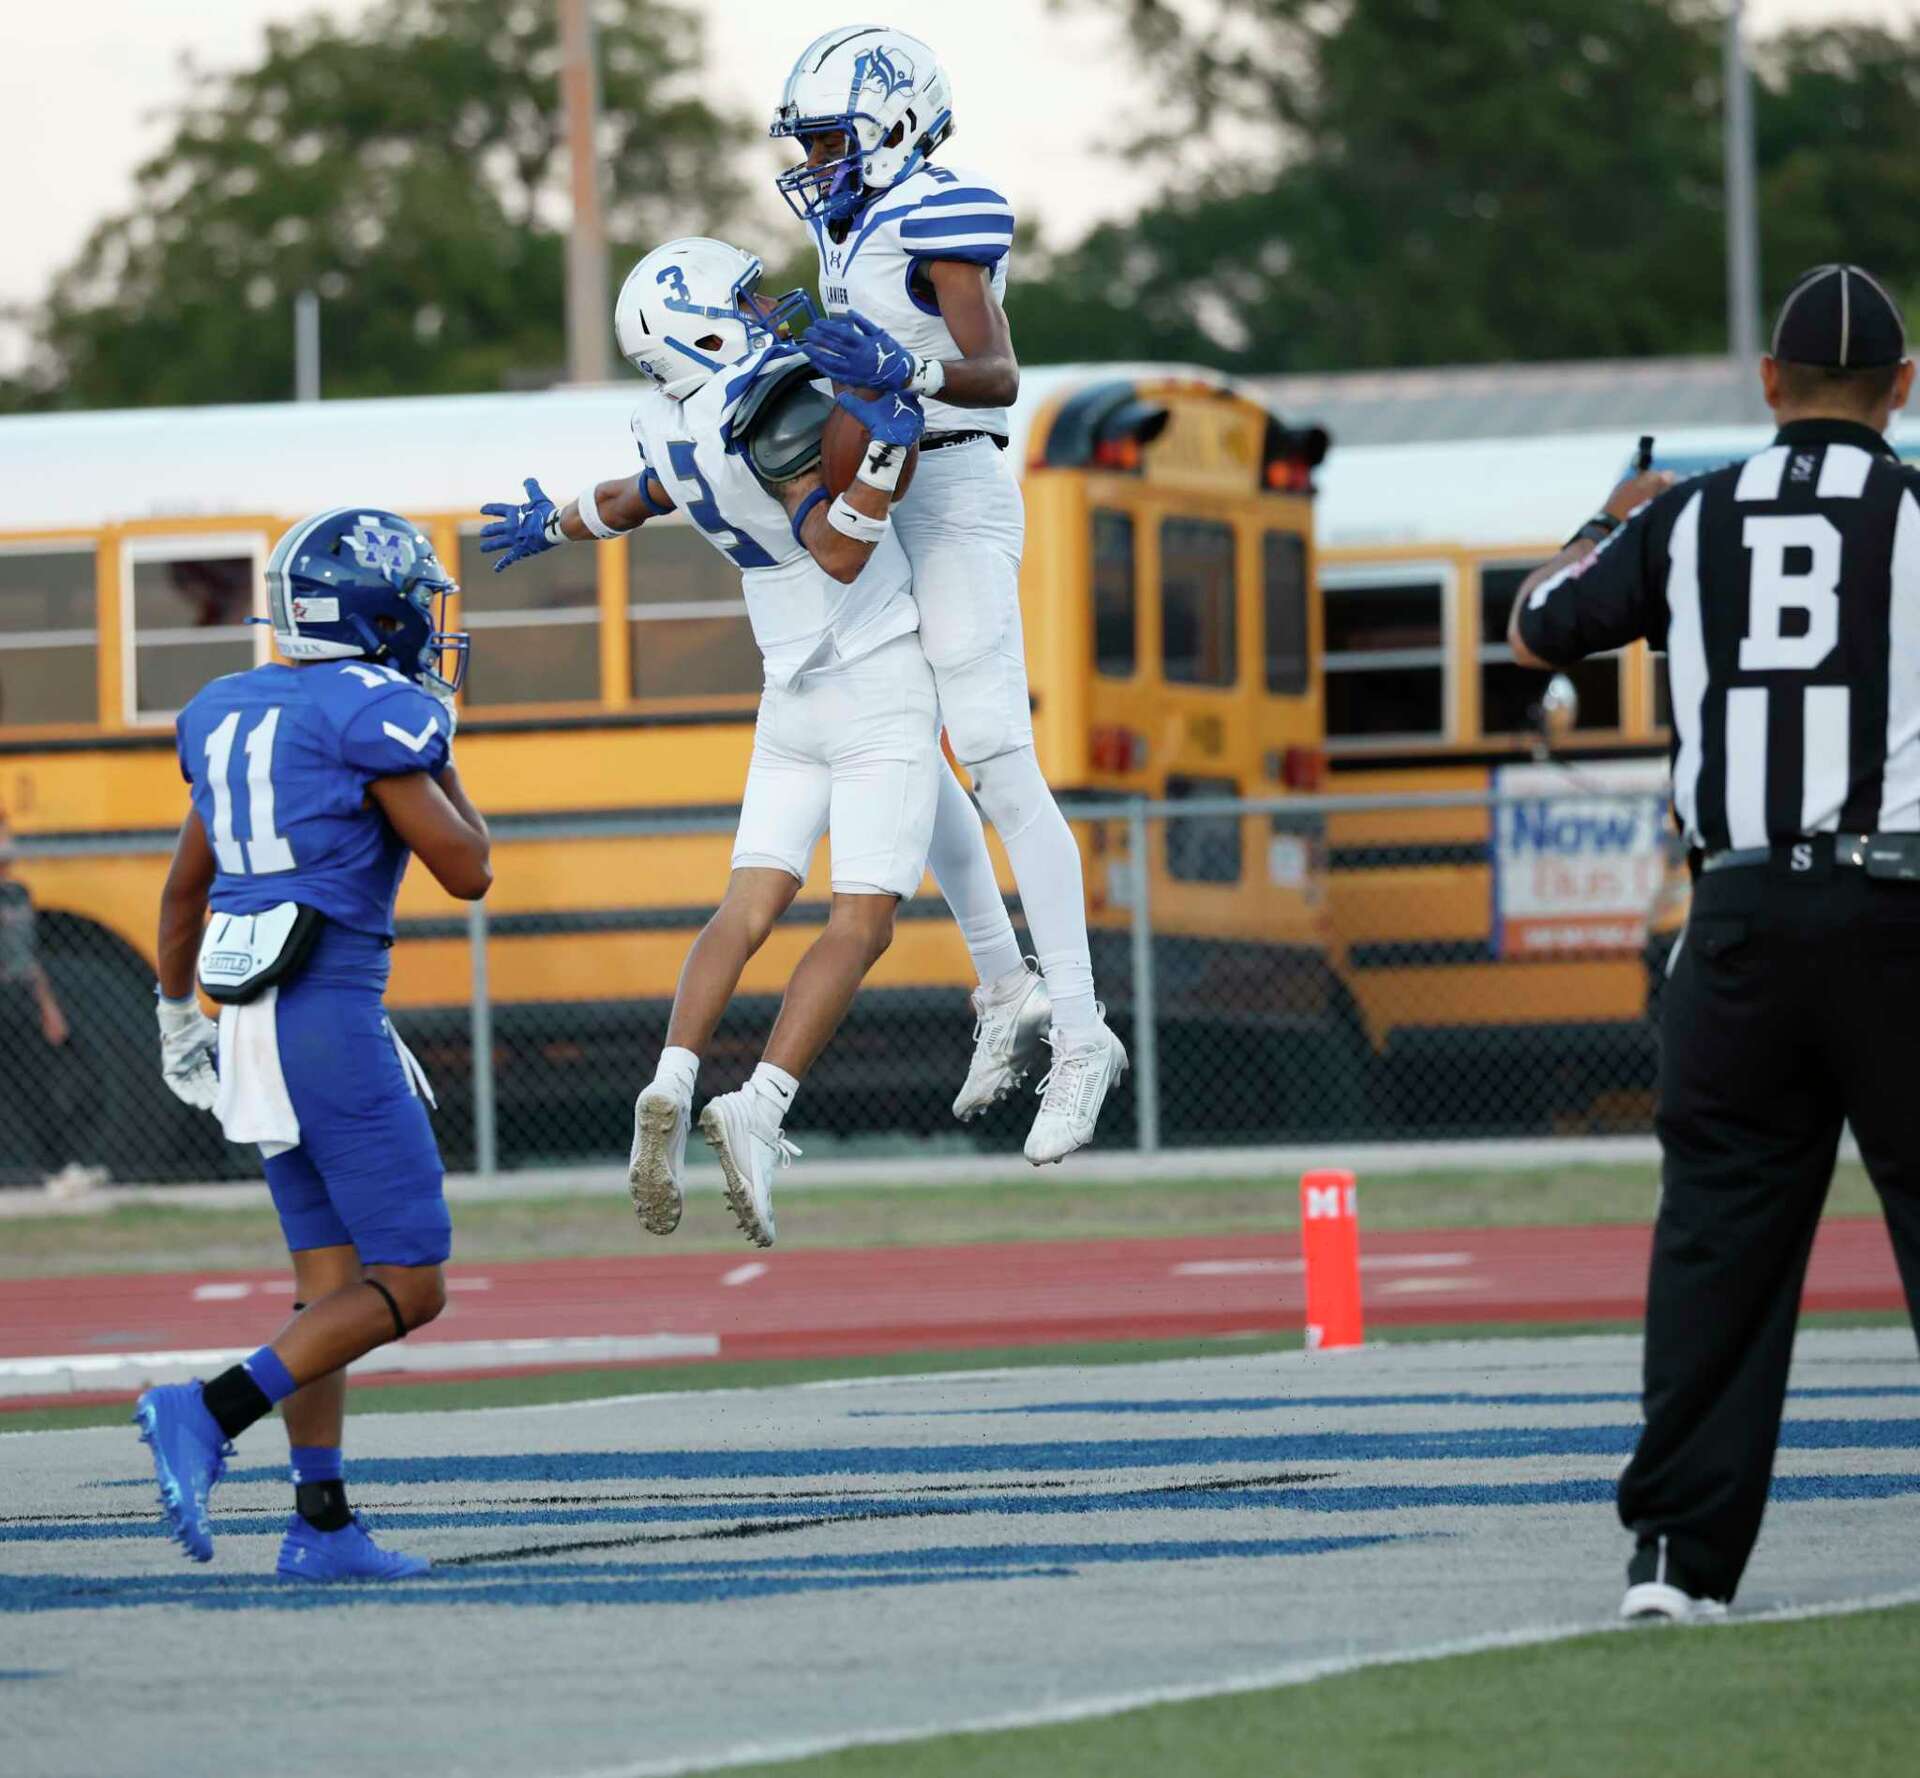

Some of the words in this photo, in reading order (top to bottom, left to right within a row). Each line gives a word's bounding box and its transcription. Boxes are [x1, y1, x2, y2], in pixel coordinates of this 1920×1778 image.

[656, 265, 691, 312] 3
[825, 285, 849, 306] LANIER
[666, 440, 781, 568] 3
[1739, 514, 1843, 671] B
[203, 707, 297, 875] 11
[1512, 798, 1635, 853] Now
[1790, 843, 1813, 872] S
